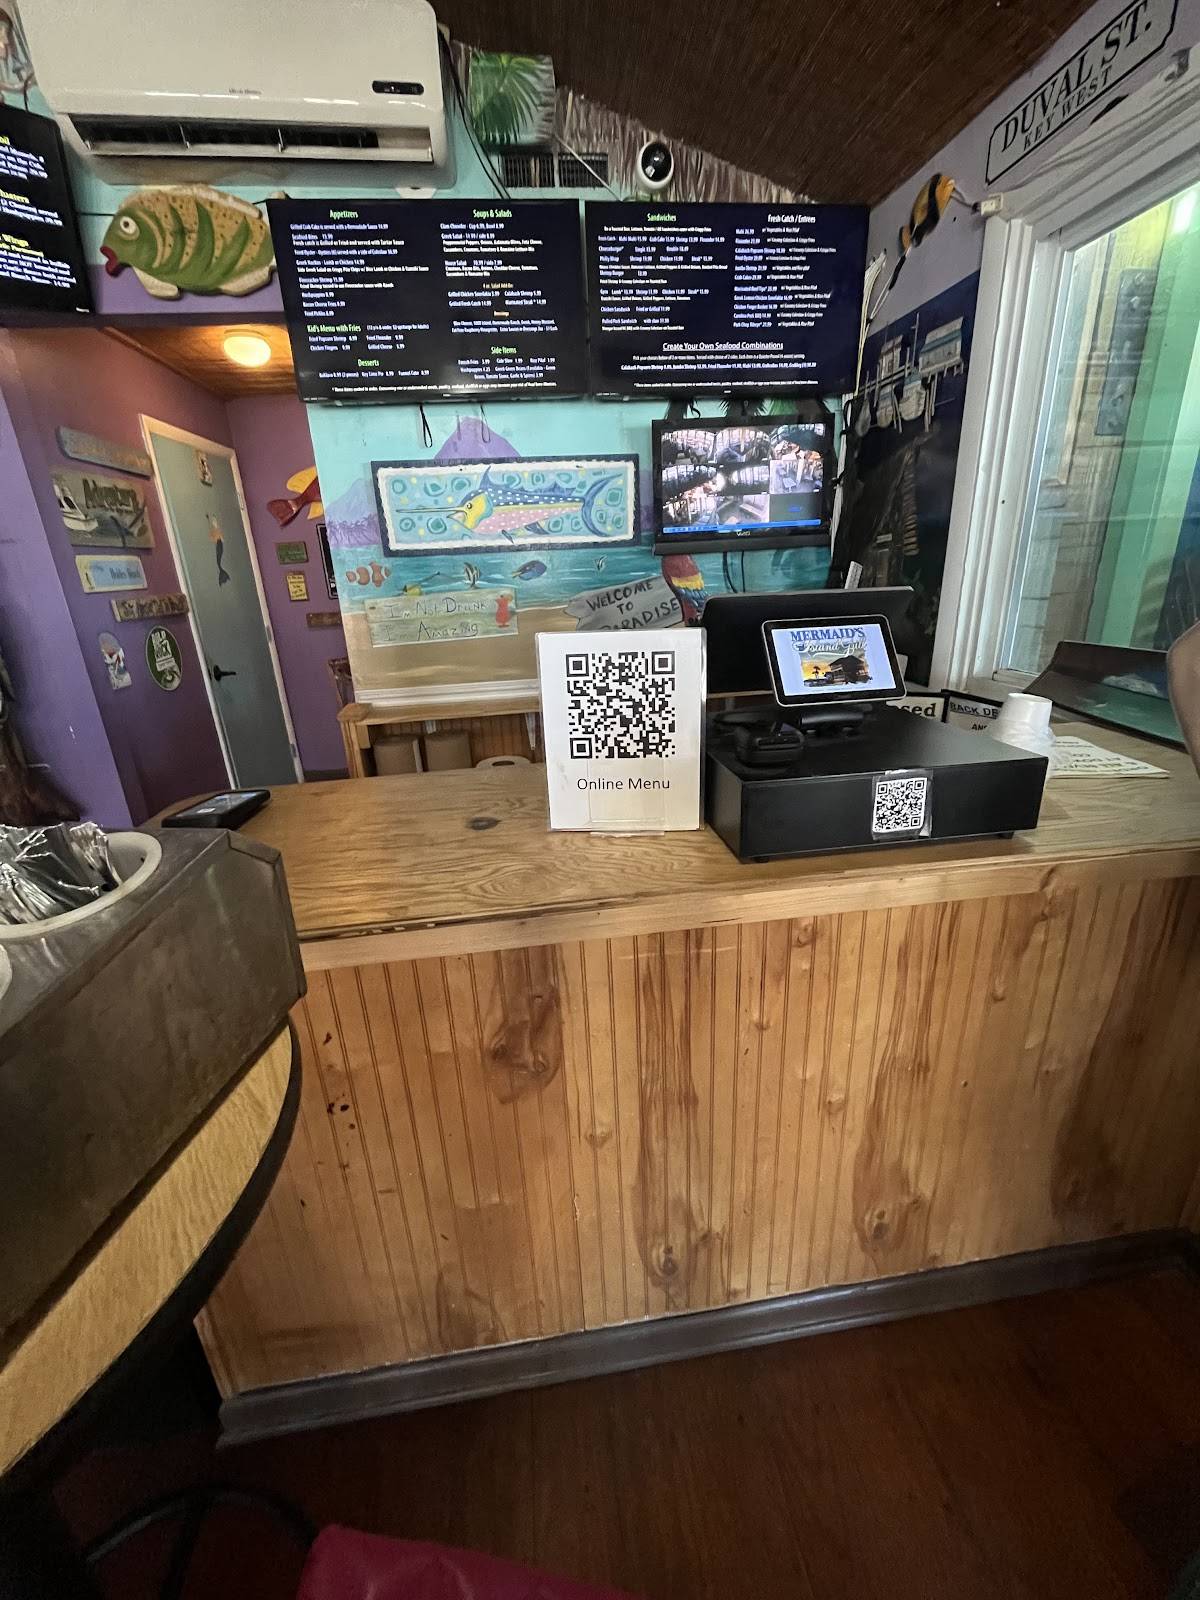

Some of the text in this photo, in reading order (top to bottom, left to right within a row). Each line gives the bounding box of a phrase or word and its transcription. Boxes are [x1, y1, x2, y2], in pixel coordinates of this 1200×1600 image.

[1002, 1, 1152, 152] DUVAL ST.
[1024, 65, 1112, 150] KEY WEST
[329, 209, 359, 220] Appetizers
[473, 209, 512, 219] Soups & Salads
[647, 213, 677, 222] Sandwiches
[767, 214, 780, 223] Fresh
[781, 215, 795, 223] Catch
[307, 325, 320, 333] Kid's
[348, 324, 361, 332] Fries
[501, 346, 516, 354] Items
[662, 342, 784, 351] Create Your Own Seafood Combinations
[358, 359, 379, 367] Desserts
[586, 580, 653, 612] WELCOME
[616, 602, 634, 615] TO
[790, 627, 865, 642] MERMAID'S
[950, 702, 978, 715] BACK
[577, 777, 670, 790] Online Menu
